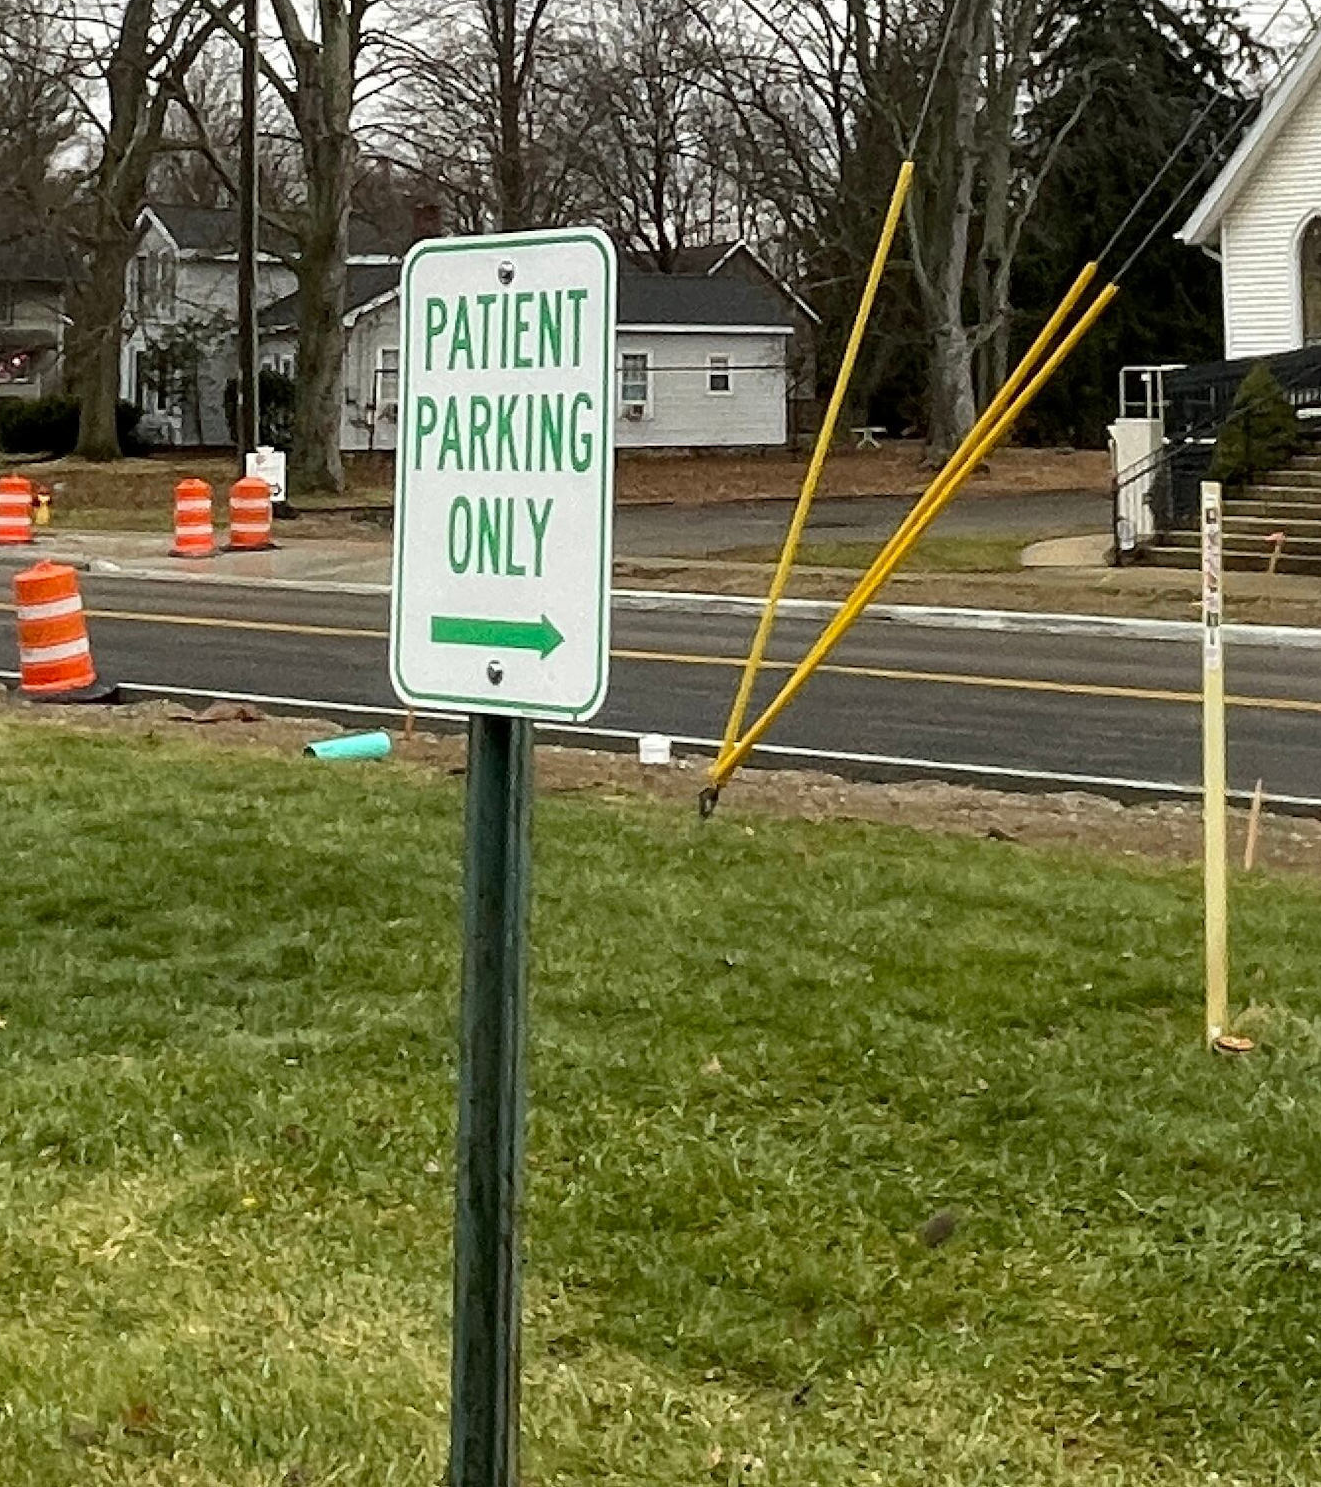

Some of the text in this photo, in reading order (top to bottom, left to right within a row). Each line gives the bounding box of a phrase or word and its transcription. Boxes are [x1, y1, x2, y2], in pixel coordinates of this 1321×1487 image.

[425, 289, 588, 371] PATIENT
[414, 393, 593, 473] PARKING
[448, 496, 553, 577] ONLY
